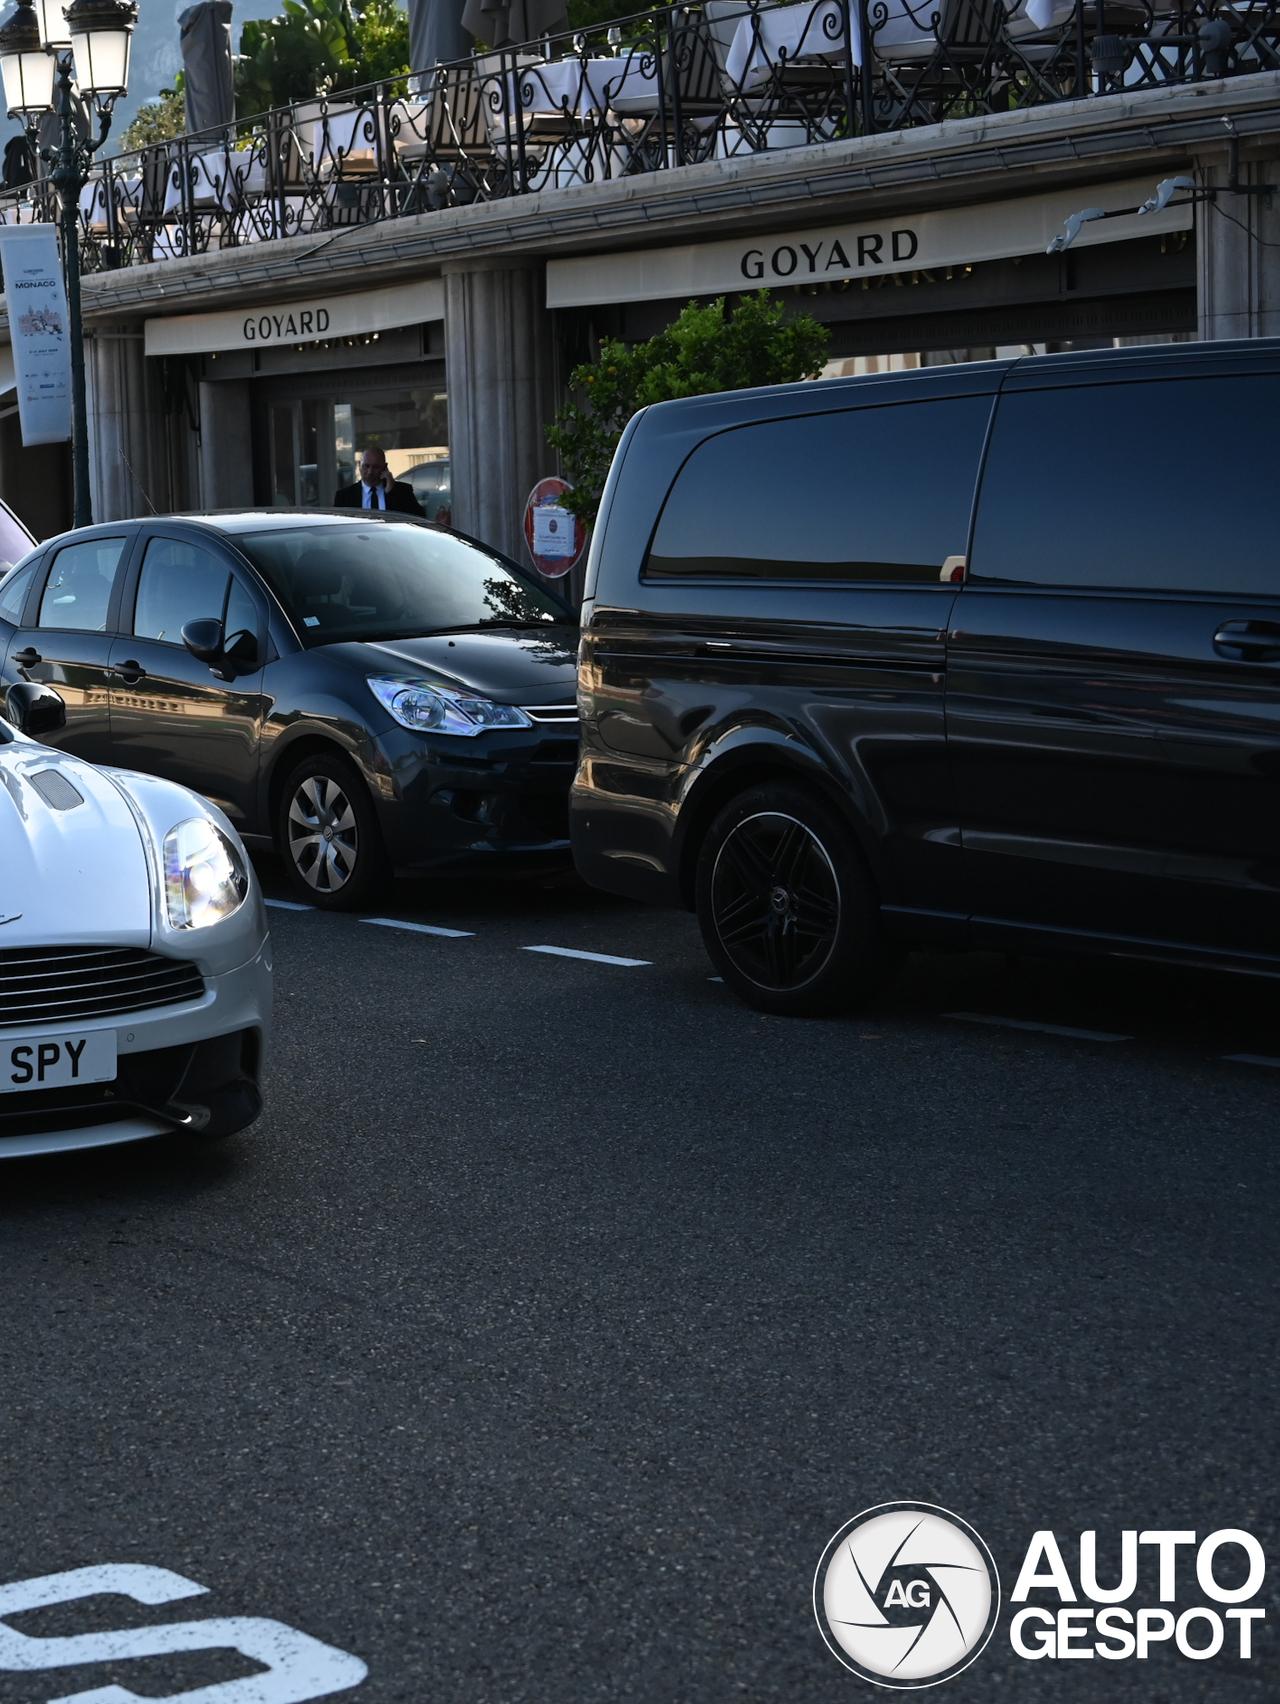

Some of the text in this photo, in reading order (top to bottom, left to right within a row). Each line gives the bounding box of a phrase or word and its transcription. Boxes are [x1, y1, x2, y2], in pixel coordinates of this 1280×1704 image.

[740, 229, 919, 279] GOYARD
[15, 281, 56, 289] MONACO
[243, 308, 330, 340] GOYARD
[10, 1039, 86, 1084] SPY
